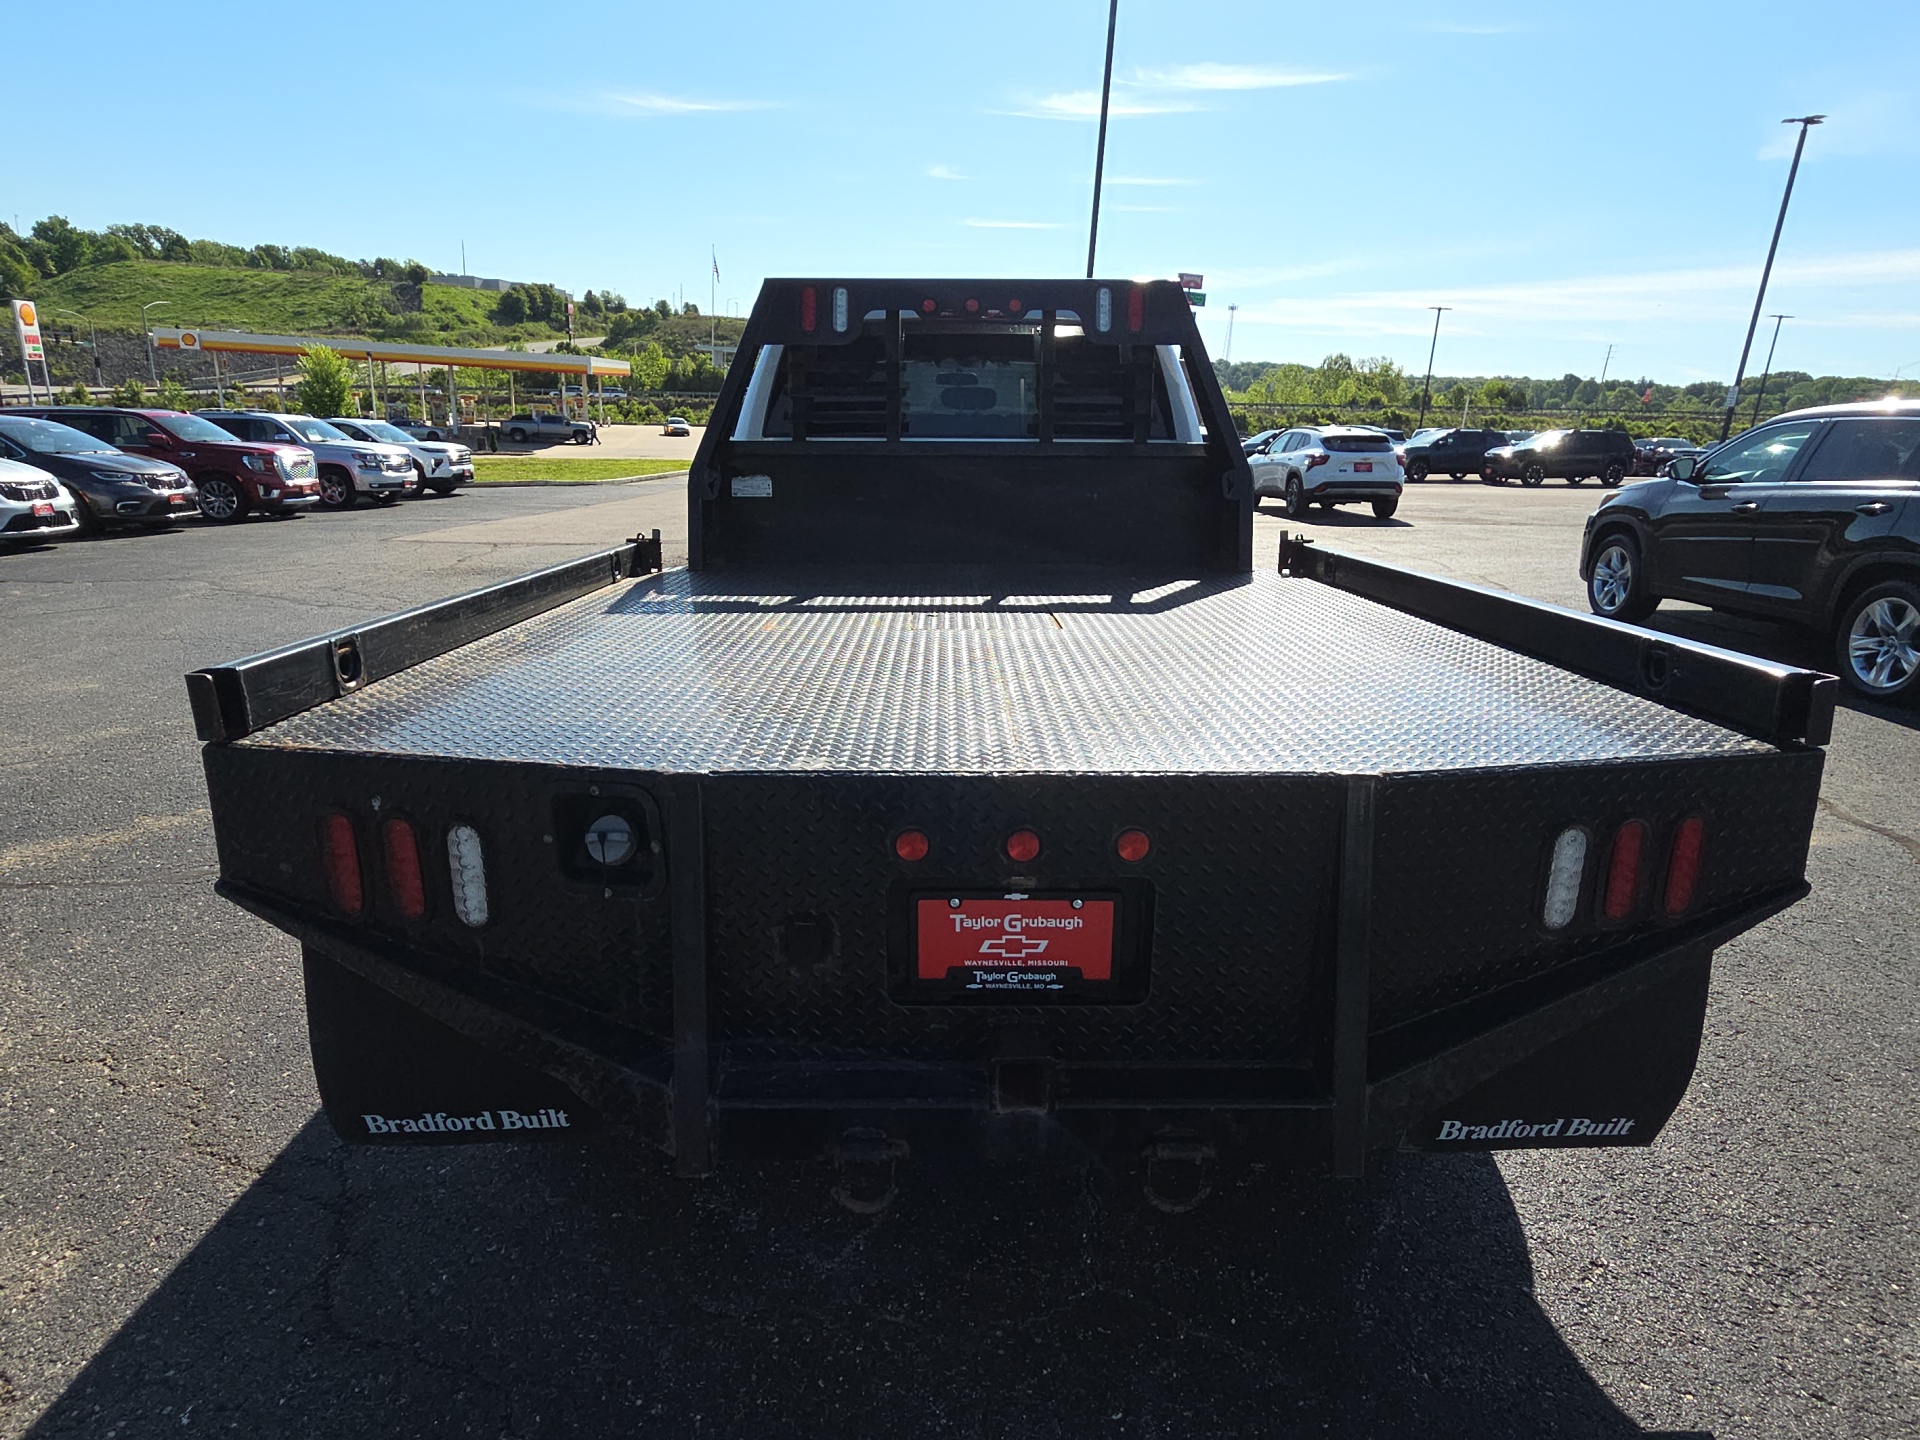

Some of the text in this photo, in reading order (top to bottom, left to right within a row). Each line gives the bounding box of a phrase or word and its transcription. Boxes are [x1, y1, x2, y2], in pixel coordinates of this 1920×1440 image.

[949, 914, 1083, 932] Taylor Grubaugh
[972, 971, 1057, 983] Taylor Grubaugh
[361, 1108, 571, 1134] Bradford Built
[1435, 1117, 1636, 1141] Bradford Built
